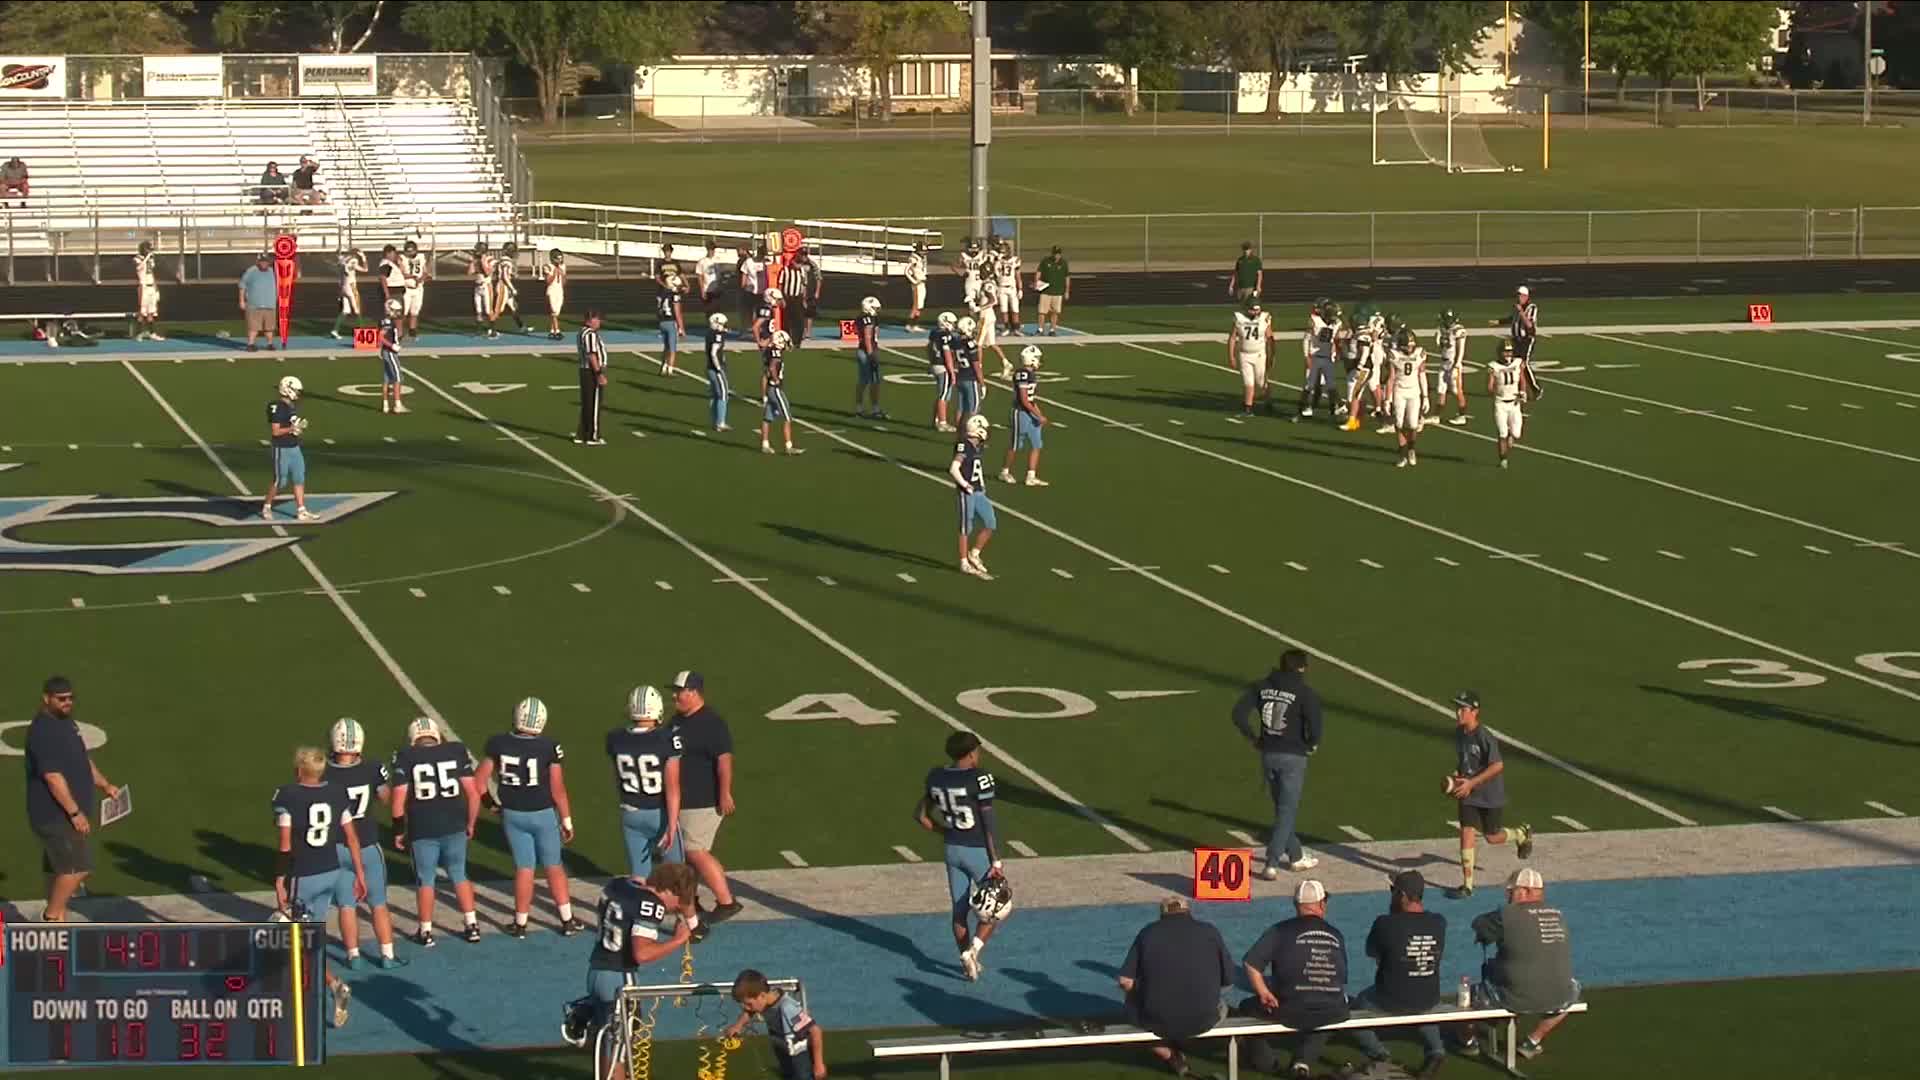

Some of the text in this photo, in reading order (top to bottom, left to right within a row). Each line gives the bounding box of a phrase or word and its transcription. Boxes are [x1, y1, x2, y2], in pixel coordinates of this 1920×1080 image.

[303, 67, 369, 77] PERFORMANCE
[1752, 306, 1769, 320] 10
[357, 330, 375, 344] 40
[1243, 326, 1260, 341] 74
[1503, 371, 1515, 386] 11
[499, 754, 540, 787] 51
[412, 760, 460, 801] 65
[306, 803, 332, 847] 8
[1200, 852, 1244, 892] 40
